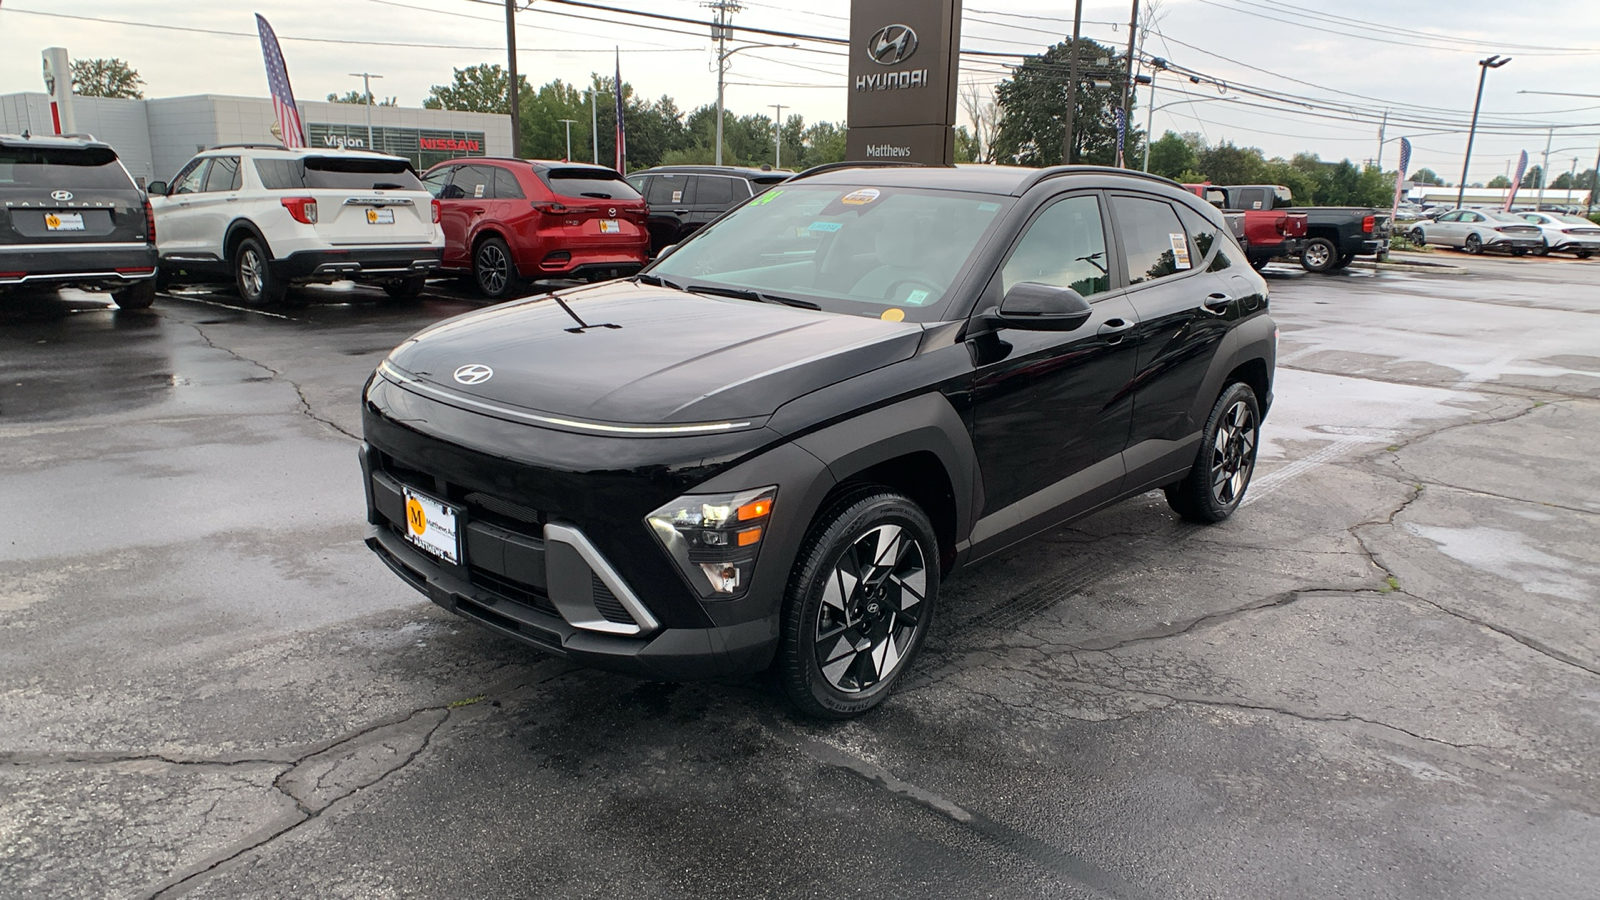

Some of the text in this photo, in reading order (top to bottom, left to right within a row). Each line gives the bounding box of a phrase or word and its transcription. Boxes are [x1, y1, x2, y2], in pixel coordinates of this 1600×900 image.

[856, 69, 928, 92] HYUNDAI
[323, 135, 364, 147] Vision
[420, 138, 479, 151] NISSAN
[866, 144, 911, 158] Matthews
[410, 506, 422, 528] M
